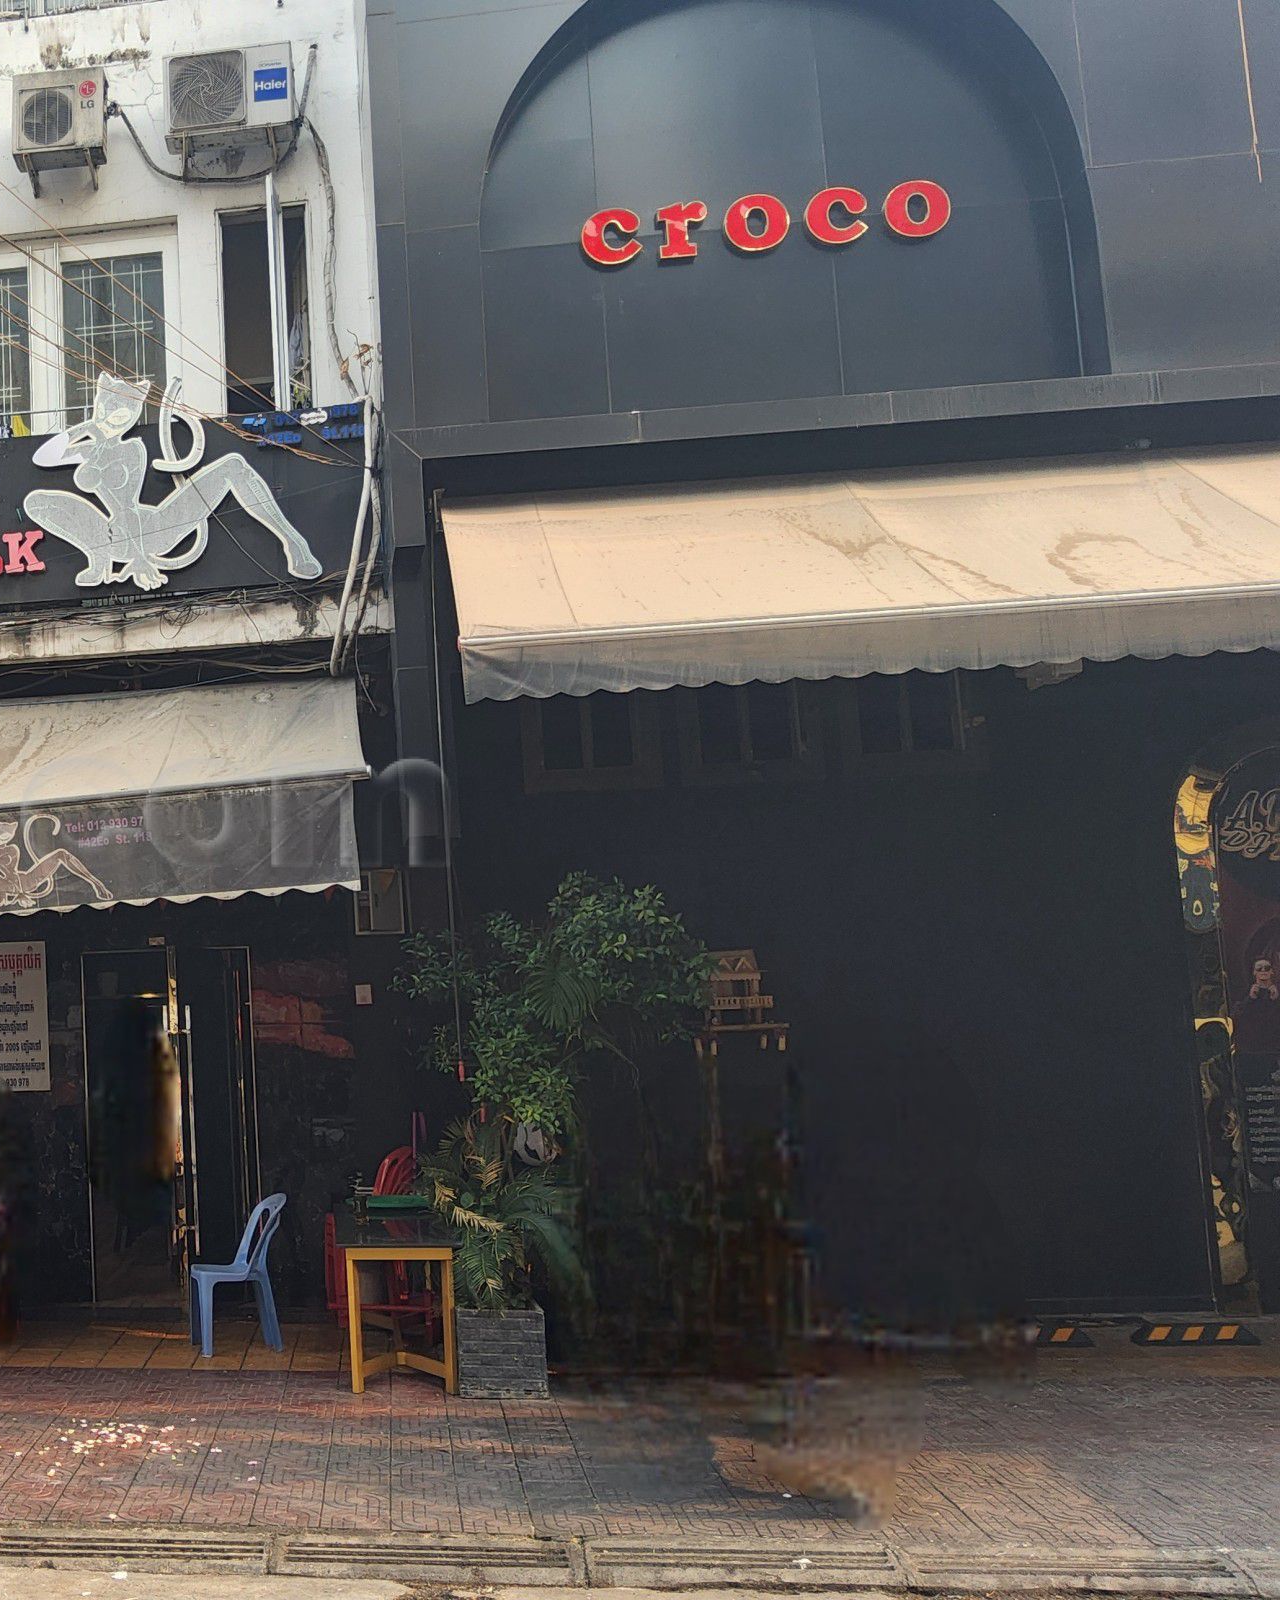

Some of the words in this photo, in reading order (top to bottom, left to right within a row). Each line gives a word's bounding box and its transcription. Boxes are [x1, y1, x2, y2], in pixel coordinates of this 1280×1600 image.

[254, 79, 287, 92] Haier
[81, 100, 95, 109] LG
[580, 179, 951, 265] croco
[65, 821, 84, 834] Tel:
[108, 817, 128, 829] 930
